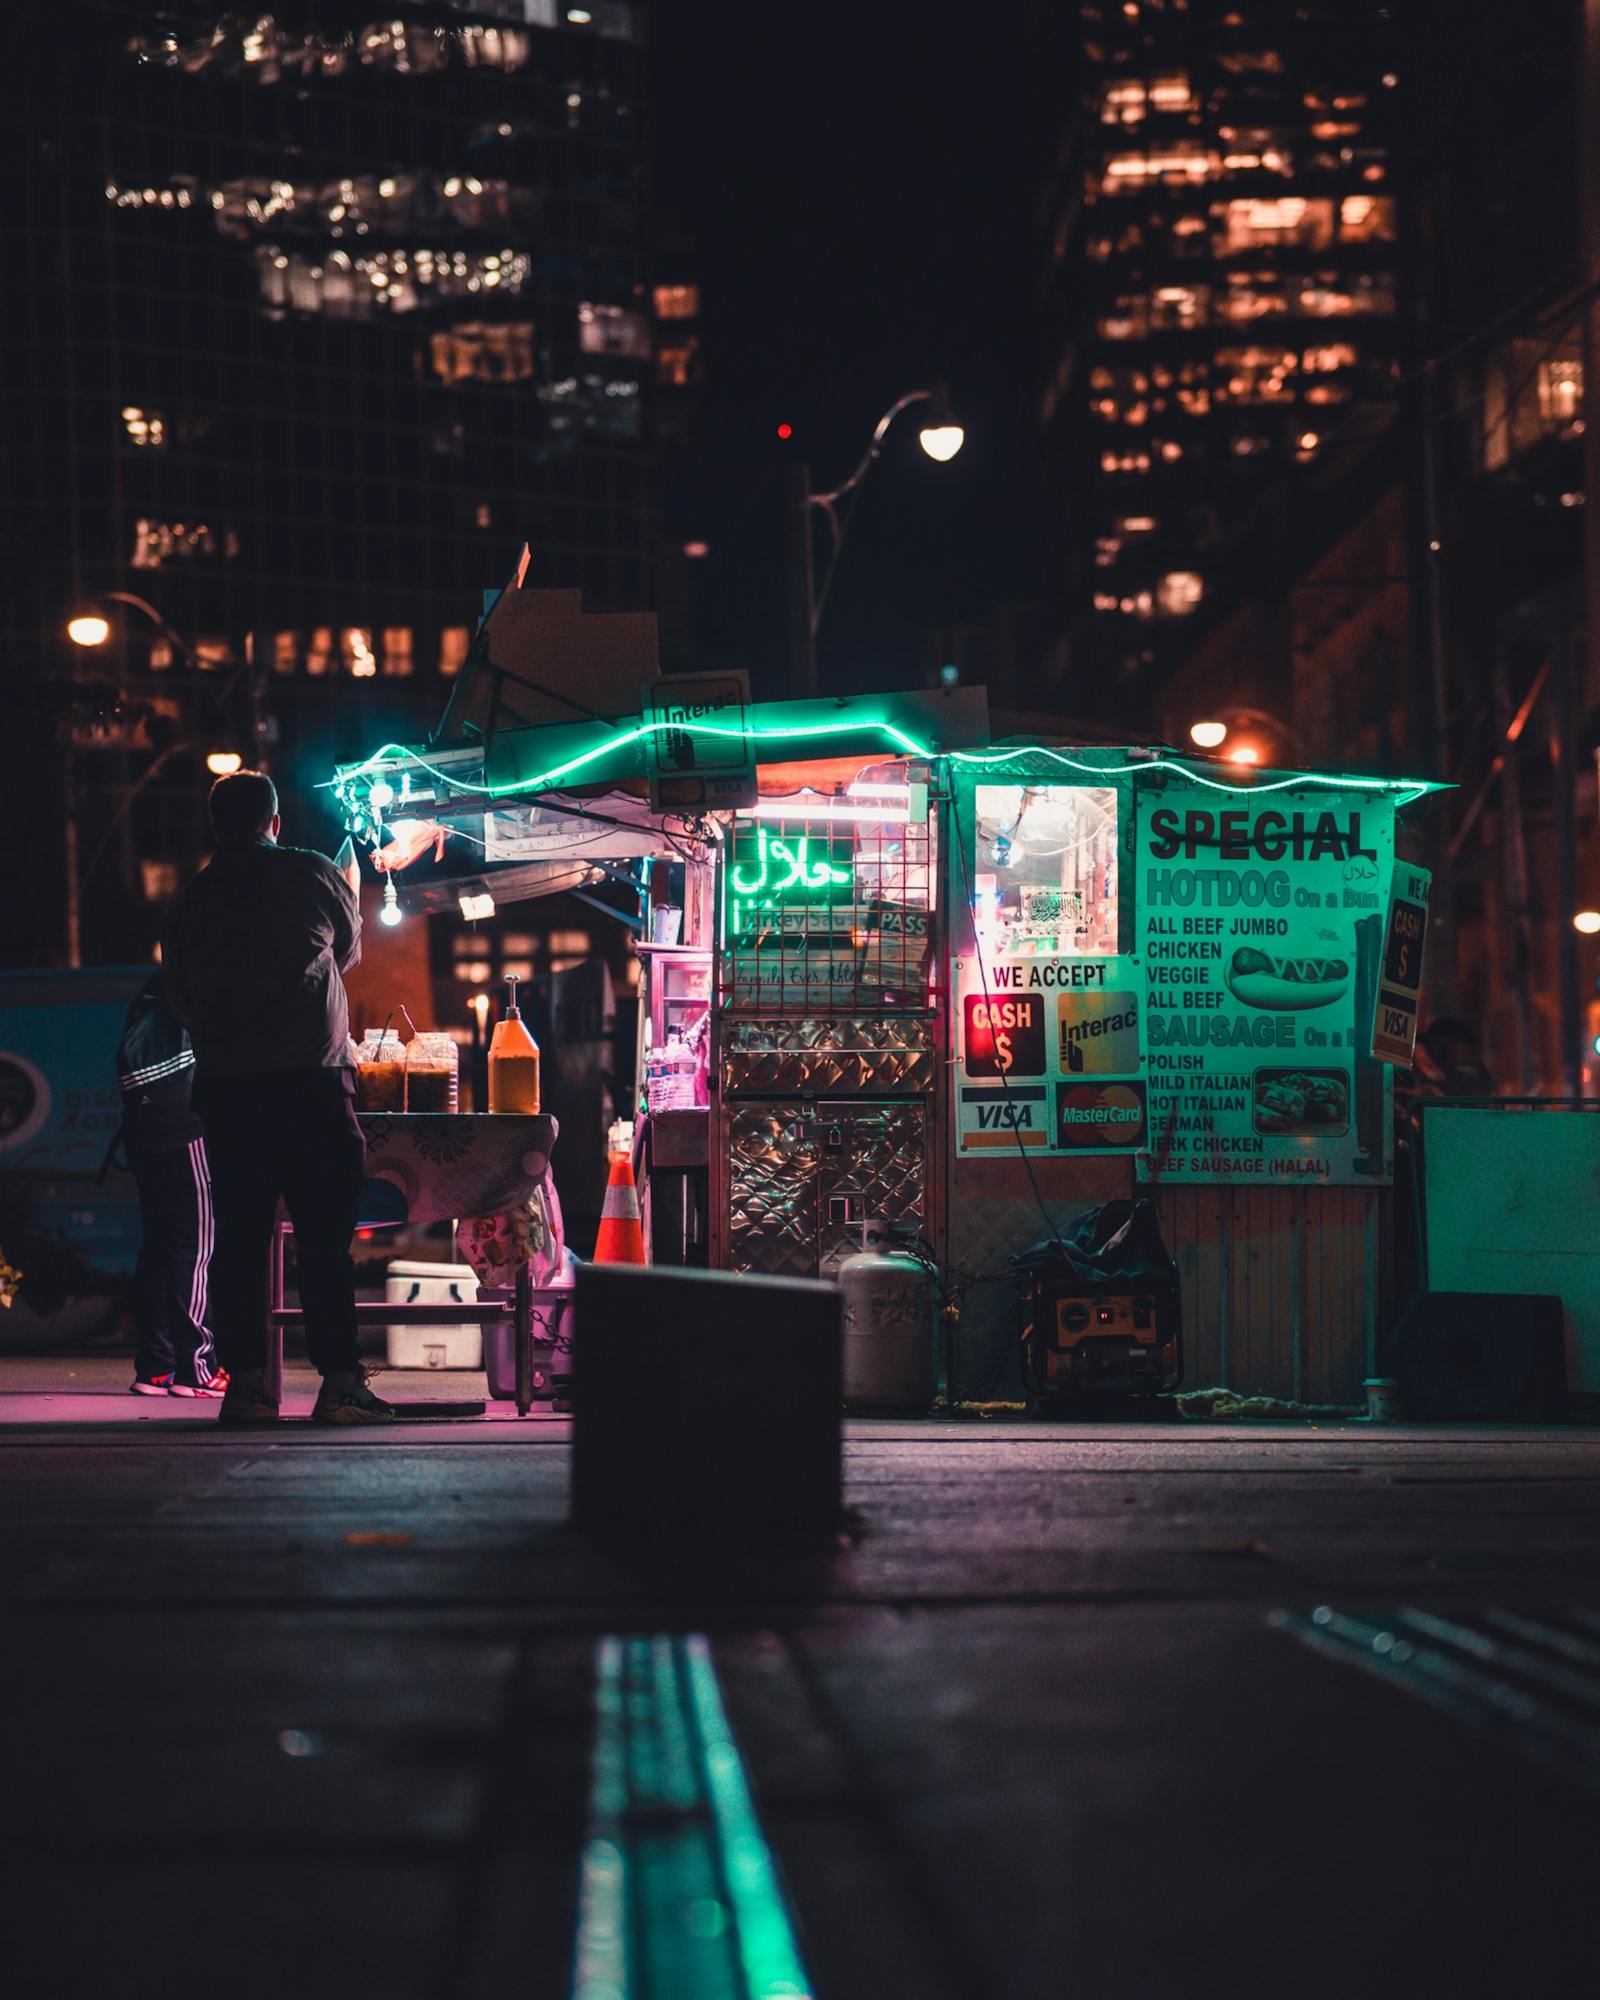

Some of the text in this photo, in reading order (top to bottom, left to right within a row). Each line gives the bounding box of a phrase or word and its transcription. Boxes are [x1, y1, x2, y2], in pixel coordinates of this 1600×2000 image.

[714, 783, 742, 794] VISA
[1149, 809, 1377, 861] SPECIAL
[1147, 868, 1379, 908] HOTDOG On a Bun
[880, 912, 927, 935] PASS
[1147, 917, 1288, 935] ALL BEEF JUMBO
[1394, 909, 1420, 941] CASH
[1147, 942, 1222, 959] CHICKEN
[993, 965, 1106, 987] WE ACCEPT
[1147, 967, 1209, 984] VEGGIE
[1147, 992, 1225, 1009] ALL BEEF
[973, 1003, 1032, 1029] CASH
[1384, 1010, 1409, 1039] VISA
[1061, 1010, 1137, 1044] Interac
[1147, 1015, 1296, 1047] SAUSAGE
[1303, 1027, 1327, 1047] On
[1331, 1031, 1342, 1047] a
[1148, 1055, 1203, 1070] POLISH
[1149, 1075, 1250, 1091] MILD ITALIAN
[1149, 1096, 1245, 1111] HOT ITALIAN
[976, 1104, 1032, 1128] VISA
[1063, 1107, 1142, 1123] MasterCard
[1149, 1116, 1214, 1131] GERMAN
[1193, 1138, 1263, 1152] CHICKEN
[1147, 1158, 1330, 1175] BEEF SAUSAGE (HALAL)
